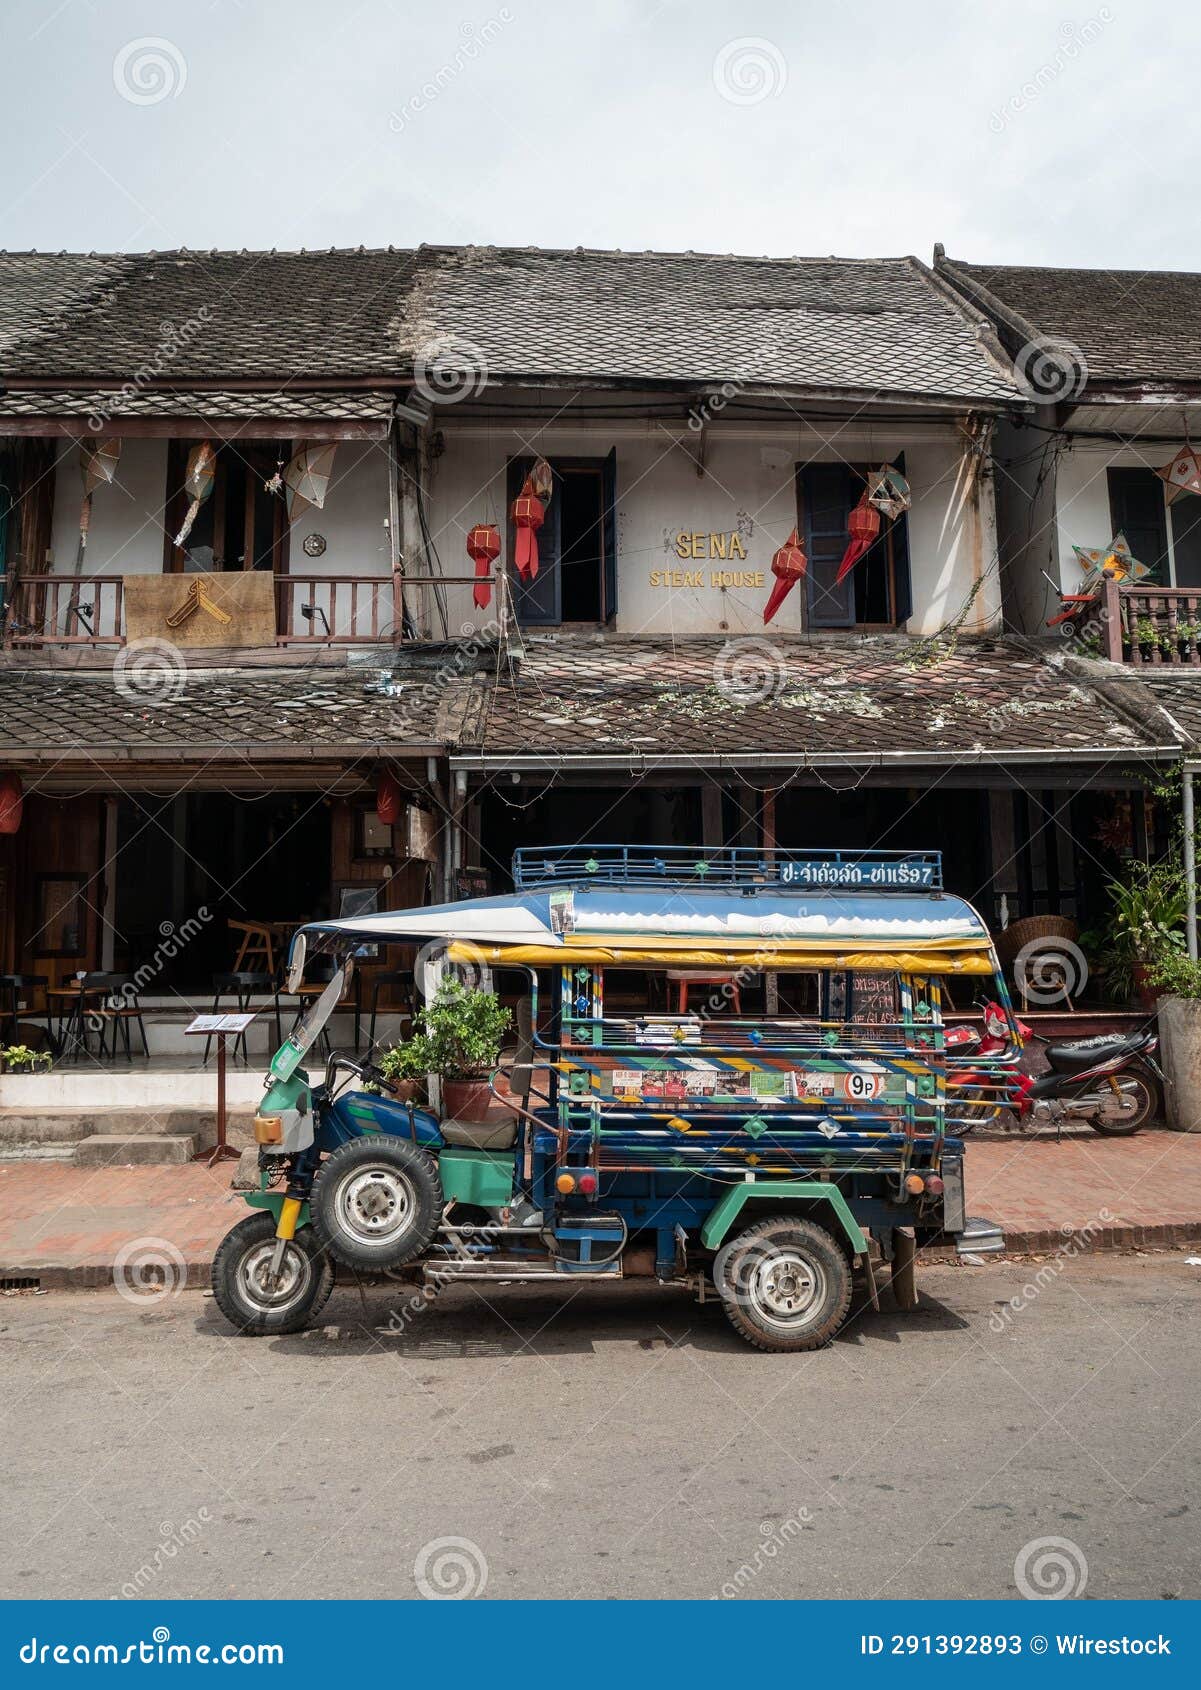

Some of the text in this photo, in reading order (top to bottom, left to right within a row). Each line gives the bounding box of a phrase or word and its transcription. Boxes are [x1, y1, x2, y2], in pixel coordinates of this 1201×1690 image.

[676, 532, 746, 559] SENA
[650, 571, 765, 588] STEAK HOUSE
